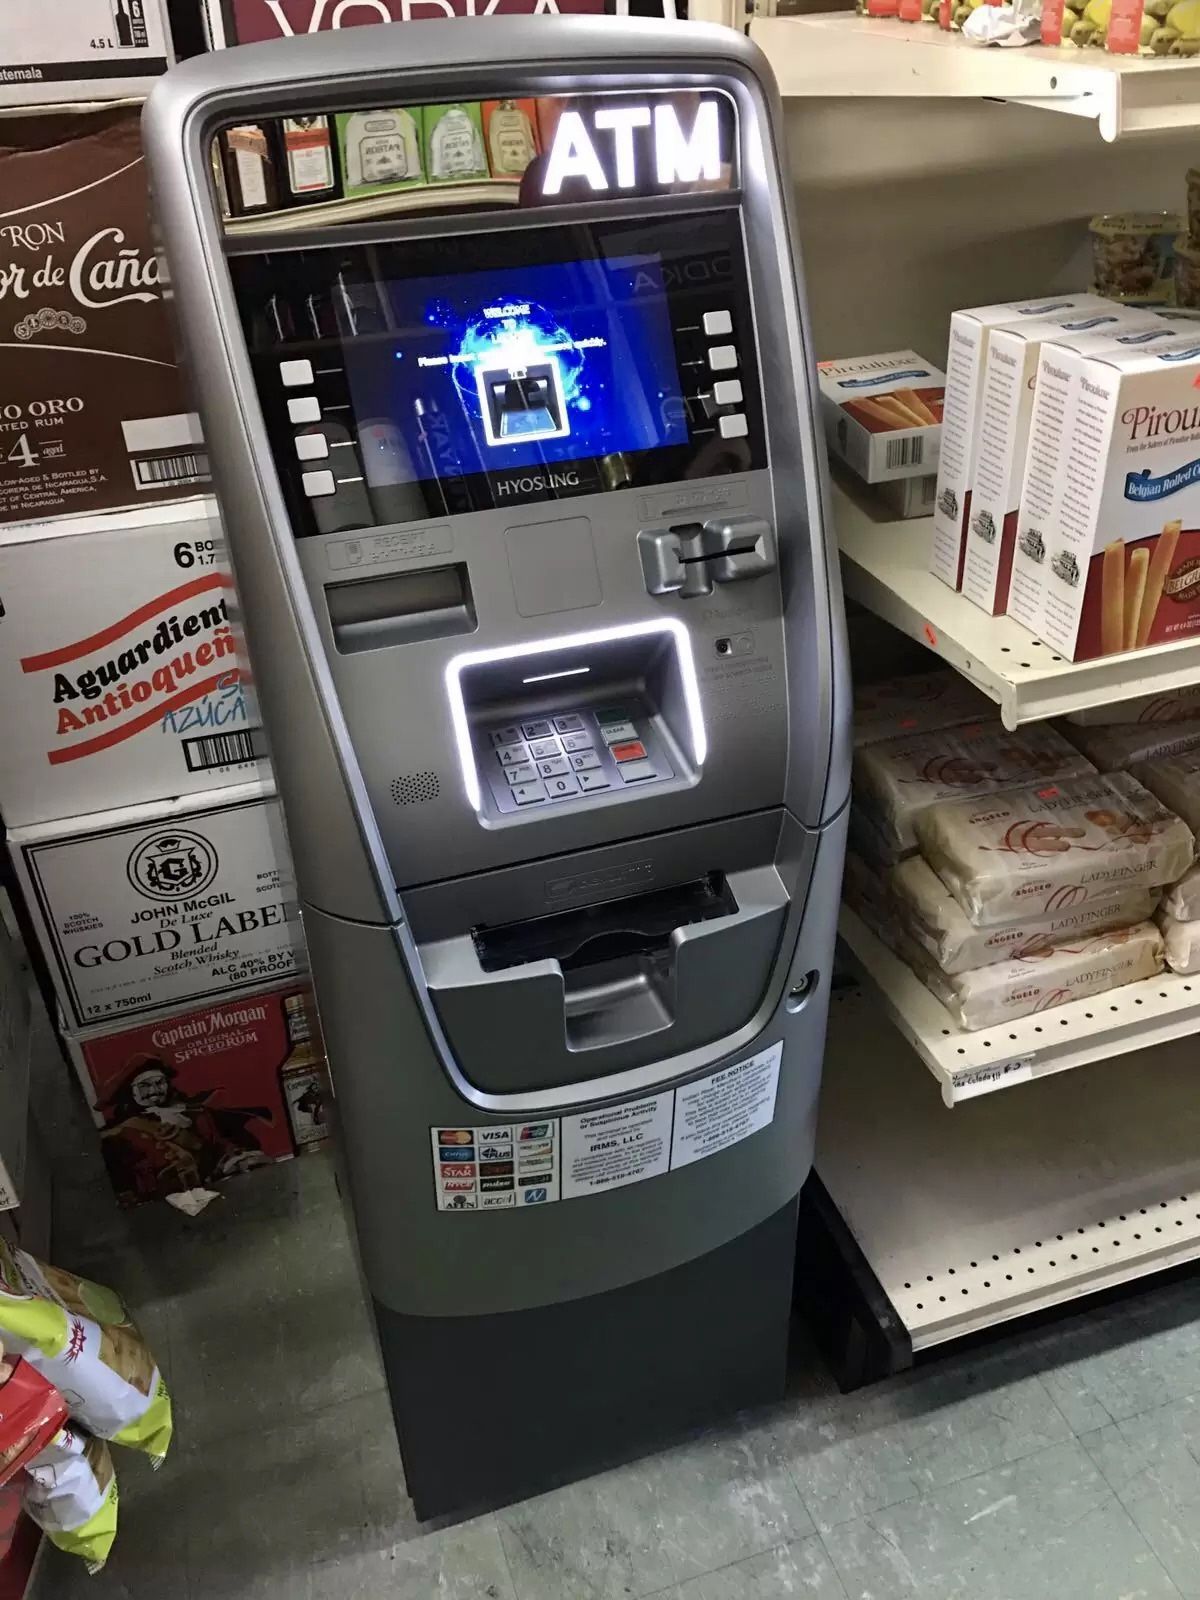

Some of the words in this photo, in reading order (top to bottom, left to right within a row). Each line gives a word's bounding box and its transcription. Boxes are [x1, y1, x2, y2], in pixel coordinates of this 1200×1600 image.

[90, 38, 106, 49] 4.5
[107, 38, 114, 49] L
[542, 99, 722, 195] ATM
[0, 221, 65, 251] RON
[32, 255, 65, 288] de
[28, 397, 84, 416] ORO
[35, 416, 64, 428] RUM
[8, 433, 40, 468] 4
[497, 472, 580, 496] HYOSUNG
[1128, 482, 1161, 498] Belgian
[1162, 467, 1191, 492] Rolled
[173, 542, 195, 569] 6
[53, 598, 229, 703] Aguardient
[56, 626, 237, 735] Antioqueñ
[527, 726, 536, 737] 2
[558, 720, 568, 730] 3
[568, 739, 576, 749] 6
[503, 751, 512, 761] 4
[575, 757, 584, 768] 9
[510, 771, 518, 781] 7
[542, 764, 552, 774] 8
[556, 780, 566, 791] 0
[1079, 860, 1158, 884] LADYFINGER
[1015, 883, 1052, 897] ANGELO
[131, 904, 179, 925] JOHN
[183, 892, 236, 913] McGIL
[1050, 903, 1121, 932] LADYFINGER
[63, 917, 99, 930] SCOTCH
[160, 918, 178, 929] De
[182, 911, 213, 924] Luxe
[987, 931, 1024, 946] ANGELO
[74, 929, 181, 969] GOLD
[170, 942, 218, 961] Blended
[154, 959, 193, 976] Scotch
[194, 949, 240, 967] Whisky
[211, 963, 237, 977] ALC
[240, 956, 266, 970] 40%
[268, 952, 286, 964] BY
[229, 970, 248, 983] (80
[1065, 958, 1134, 988] LADYFINGER
[87, 1005, 101, 1015] 12
[114, 992, 152, 1008] 750ml
[152, 1018, 208, 1048] Captain
[206, 1003, 267, 1036] Morgan
[187, 1029, 243, 1049] ORIGINAL
[711, 1074, 726, 1085] FEE
[727, 1060, 755, 1077] NOTICE
[482, 1131, 510, 1140] VISA
[623, 1133, 644, 1144] LLC
[443, 1166, 472, 1177] STAR
